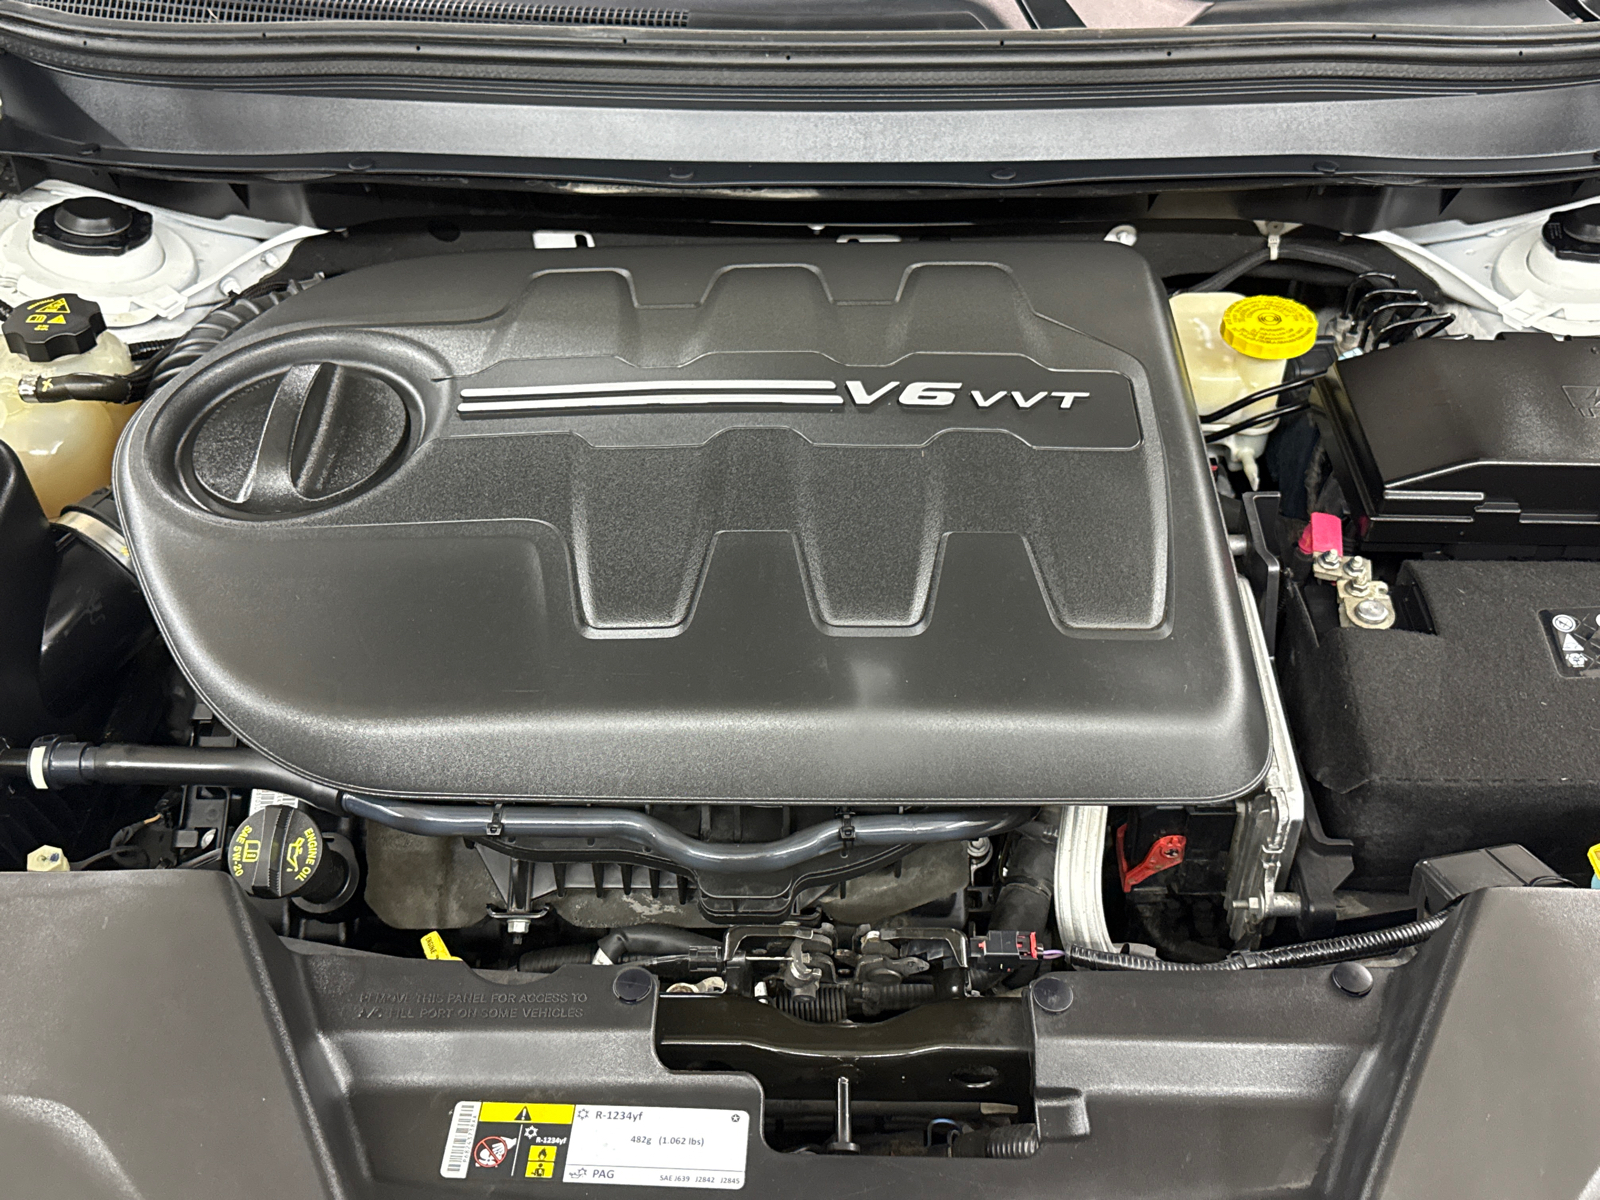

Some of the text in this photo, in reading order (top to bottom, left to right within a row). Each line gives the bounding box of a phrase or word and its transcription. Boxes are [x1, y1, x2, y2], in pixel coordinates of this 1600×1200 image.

[846, 381, 1090, 409] V6 VVT
[232, 825, 252, 877] SAE 5W-20
[295, 827, 317, 881] ENGINE OIL
[415, 992, 443, 1004] THIS
[447, 993, 487, 1004] PANEL
[491, 993, 516, 1004] FOR
[520, 992, 568, 1004] ACCESS
[571, 992, 587, 1003] TO
[420, 1008, 453, 1018] PORT
[458, 1008, 477, 1018] ON
[481, 1008, 517, 1018] SOME
[523, 1008, 583, 1018] VEHICLES
[595, 1111, 643, 1122] R-1234yf
[535, 1137, 567, 1146] R-1234yf
[630, 1135, 705, 1147] 482g (1.062 lbs)
[592, 1169, 615, 1179] PAG
